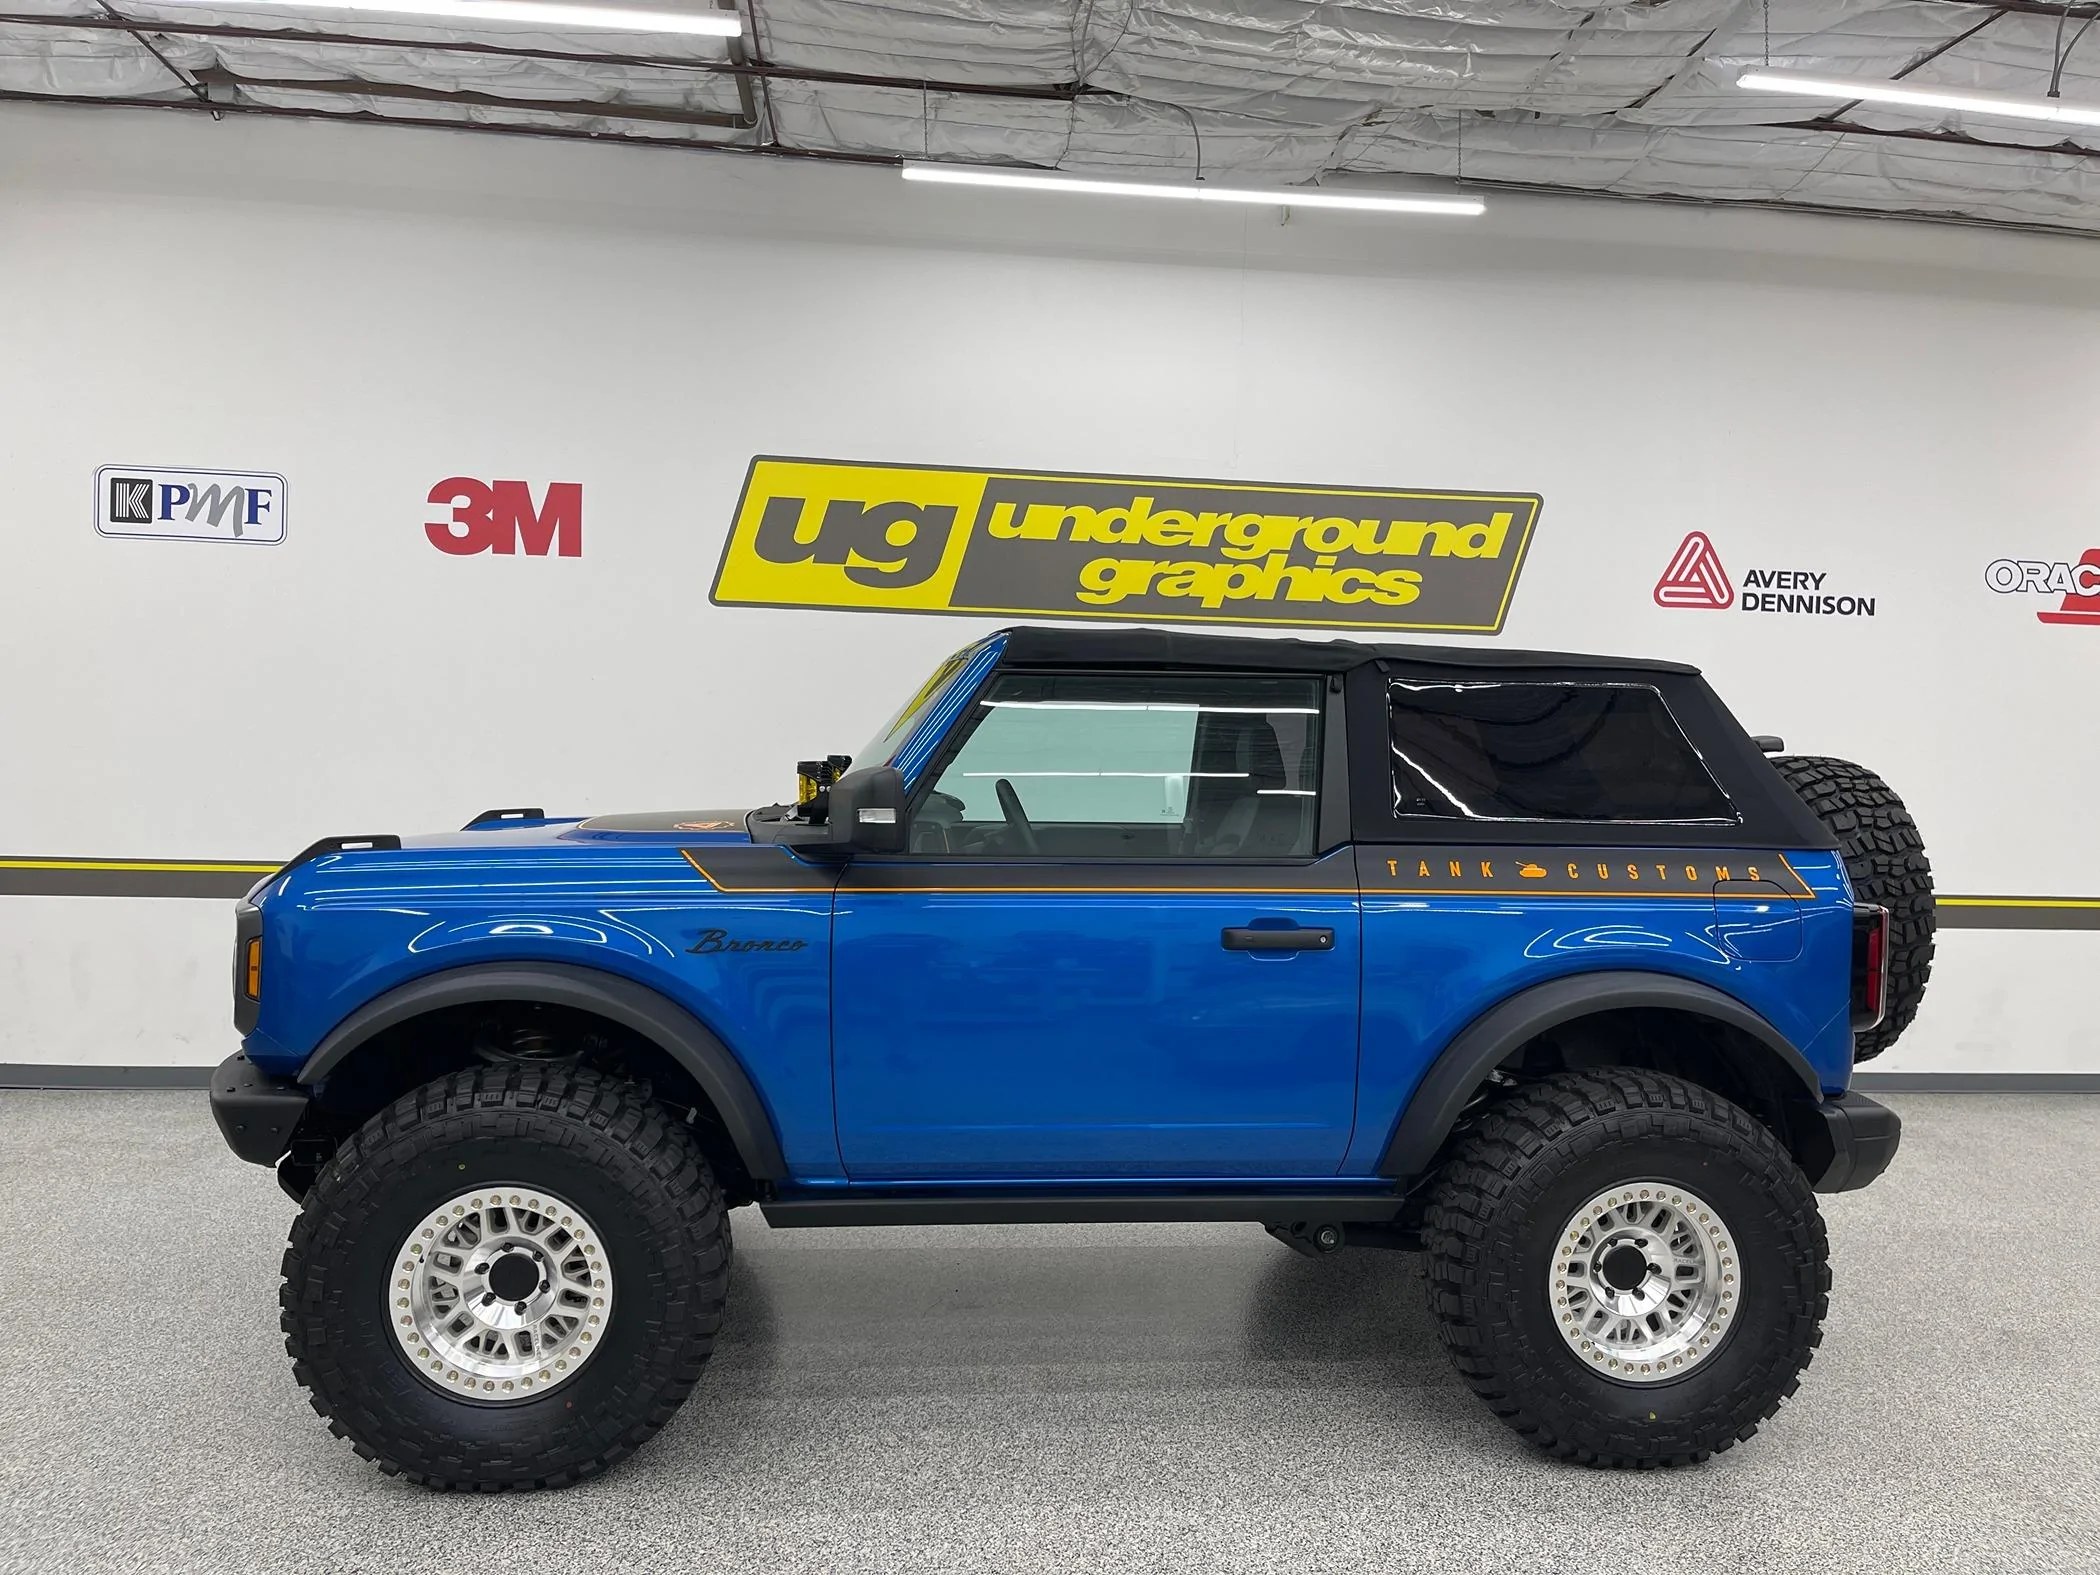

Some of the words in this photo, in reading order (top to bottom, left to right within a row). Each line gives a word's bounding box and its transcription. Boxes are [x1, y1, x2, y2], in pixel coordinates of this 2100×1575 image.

[110, 477, 273, 538] KPMF
[425, 476, 583, 557] 3M
[987, 496, 1512, 561] underground
[753, 496, 958, 589] ug
[1075, 555, 1424, 609] graphics
[1741, 592, 1876, 617] DENNISON
[1742, 569, 1828, 591] AVERY
[1386, 859, 1494, 878] TANK
[1567, 862, 1761, 882] CUSTOMS
[685, 928, 808, 954] Bronco
